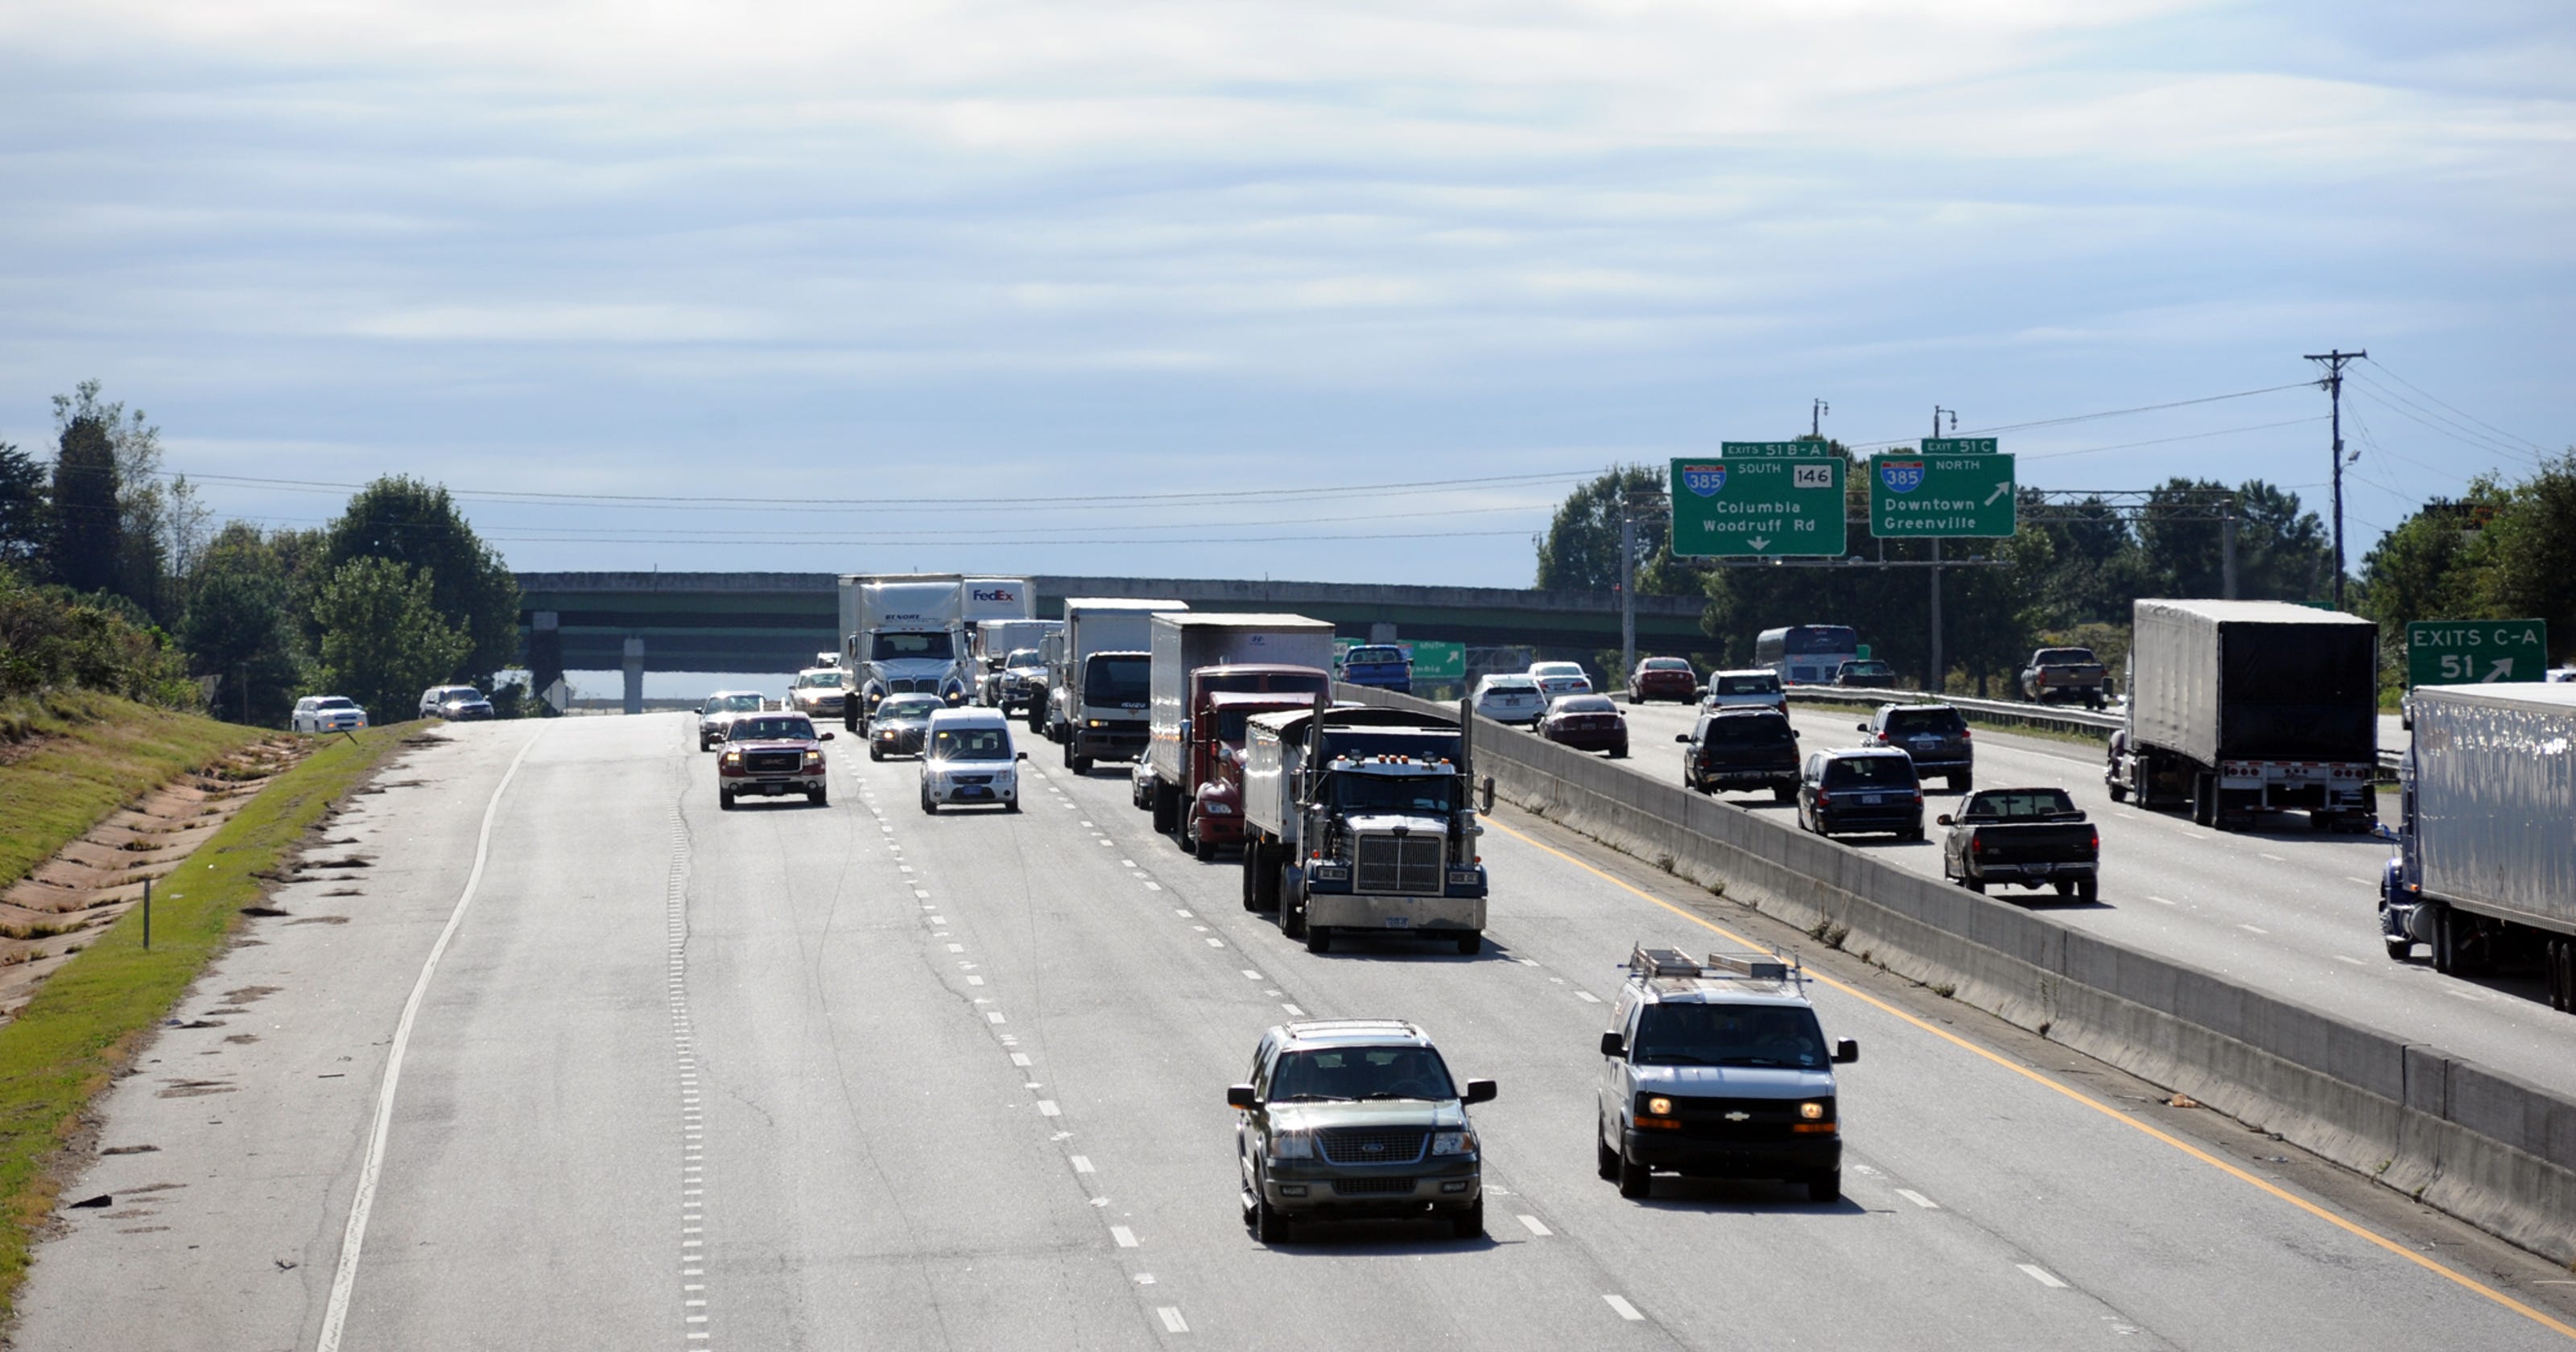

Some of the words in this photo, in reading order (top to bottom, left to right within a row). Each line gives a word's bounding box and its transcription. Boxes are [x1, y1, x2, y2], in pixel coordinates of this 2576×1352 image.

[1728, 445, 1759, 455] EXITS
[1765, 444, 1781, 455] 51
[1928, 443, 1951, 451] EXIT
[1959, 440, 1976, 452] 51
[1981, 440, 1991, 452] C
[1738, 463, 1781, 474] SOUTH
[1936, 460, 1980, 470] NORTH
[1690, 474, 1721, 488] 385
[1797, 469, 1828, 482] 146
[1887, 470, 1918, 485] 385
[1716, 501, 1801, 513] Columbia
[1885, 498, 1975, 511] Downtown
[1703, 519, 1781, 532] Woodruff
[1794, 519, 1815, 532] Rd
[1885, 517, 1975, 529] Greenville
[973, 589, 1013, 601] FedEx
[2413, 629, 2482, 646] EXITS
[2441, 654, 2473, 678] 51
